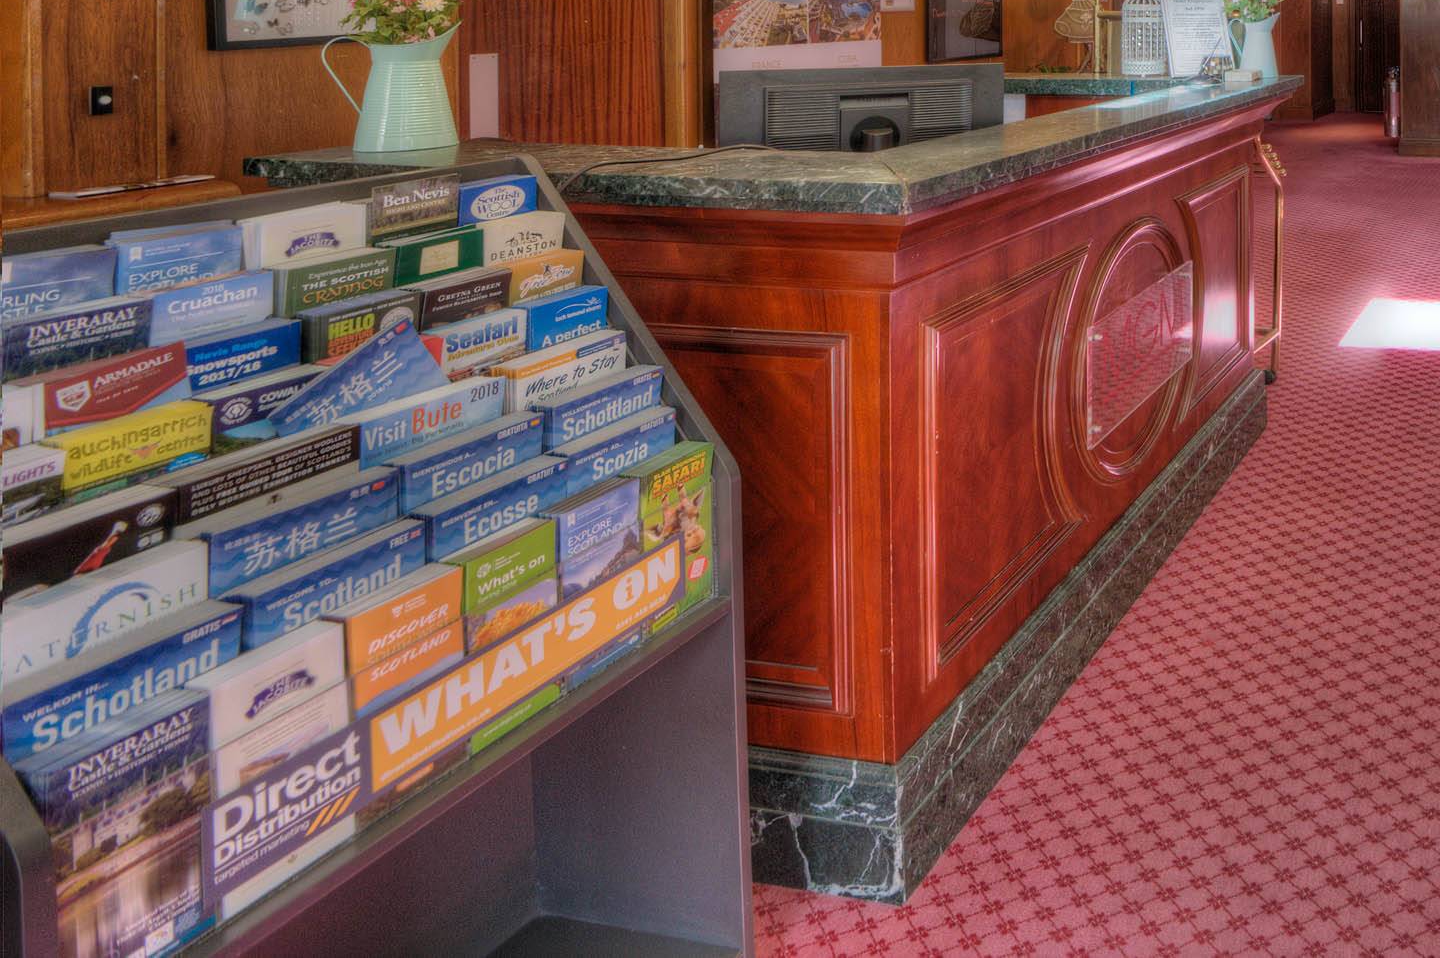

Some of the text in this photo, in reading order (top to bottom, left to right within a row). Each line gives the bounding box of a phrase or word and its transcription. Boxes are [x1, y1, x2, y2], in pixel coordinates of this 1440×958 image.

[383, 186, 450, 208] Ben Nevis
[477, 200, 519, 214] WOOL
[478, 189, 521, 203] Scottish
[490, 240, 557, 261] DEANSTON
[129, 263, 199, 285] EXPLORE
[301, 267, 390, 292] THE SCOTTISH
[168, 287, 258, 315] Cruachan
[29, 306, 138, 340] INVERARAY
[328, 313, 375, 340] HELLO
[446, 315, 519, 354] Seafari
[542, 320, 602, 348] A perfect
[94, 352, 174, 389] ARMADALE
[187, 346, 278, 376] Snowsports
[198, 361, 262, 386] 2017/18
[526, 373, 569, 398] Where
[572, 366, 586, 380] to
[589, 353, 621, 375] Stay
[470, 380, 500, 403] 2018
[364, 418, 407, 451] Visit
[411, 401, 463, 435] Bute
[562, 385, 654, 441] Schottland
[69, 414, 207, 460] auchingarrich
[70, 434, 206, 480] wildlife centre
[432, 446, 517, 499] Escocia
[592, 441, 649, 481] Scozia
[652, 457, 706, 492] SAFARI
[464, 494, 539, 544] Ecosse
[567, 516, 613, 548] EXPLORE
[389, 532, 409, 549] FREE
[283, 553, 403, 633] Scotland
[478, 561, 526, 596] What's
[528, 554, 546, 569] on
[266, 584, 315, 611] WELCOME
[182, 622, 221, 644] GRATIS
[368, 604, 449, 654] DISCOVER
[371, 629, 452, 683] SCOTLAND
[379, 597, 597, 755] WHAT'S
[612, 546, 676, 611] ON
[23, 692, 83, 722] WELKOM
[31, 638, 219, 753] Schotland
[67, 707, 195, 783] INVERARAY
[68, 763, 118, 791] Castle
[134, 723, 193, 757] Gardens
[213, 731, 361, 847] Direct
[214, 766, 361, 868] Distribution
[214, 819, 310, 885] targeted marketing
